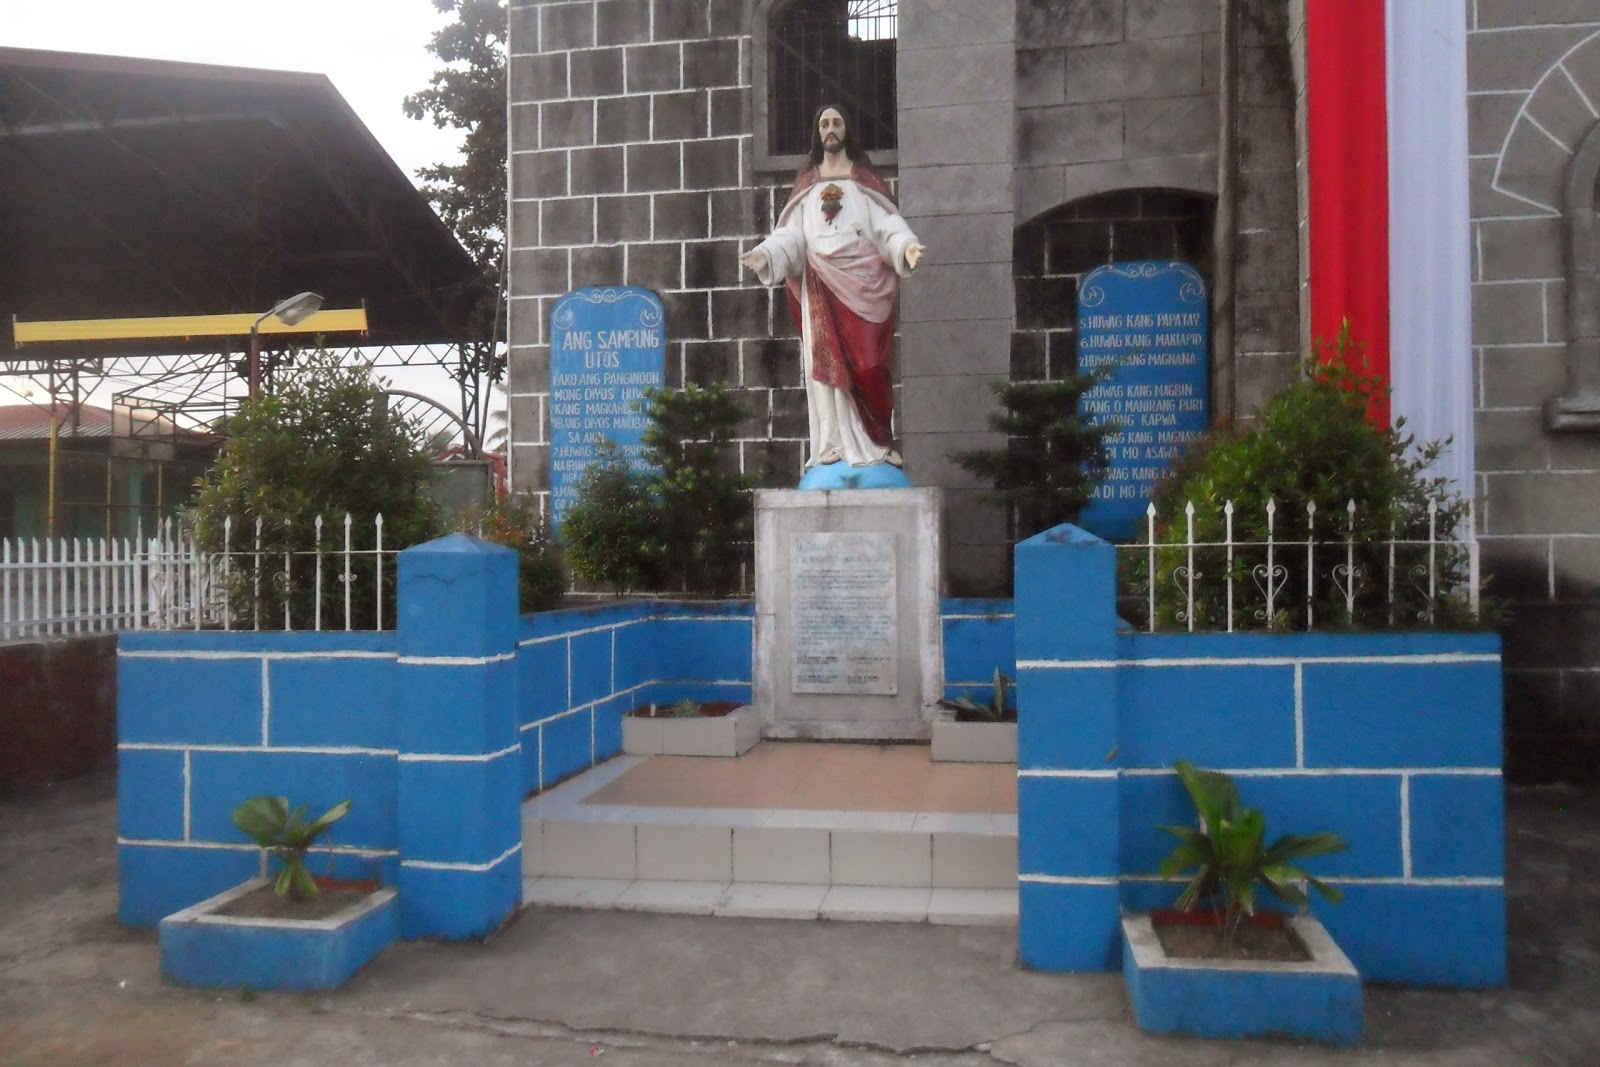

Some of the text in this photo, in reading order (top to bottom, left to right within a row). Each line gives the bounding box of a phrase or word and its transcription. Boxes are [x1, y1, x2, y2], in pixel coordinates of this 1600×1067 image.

[1126, 314, 1154, 328] KANG
[1157, 312, 1200, 327] PAPATAY
[562, 329, 659, 351] ANG SAMPUNG
[1125, 333, 1152, 347] KANG
[585, 351, 620, 369] UTOS
[579, 372, 600, 385] ANG
[603, 371, 659, 385] PANGINOON
[554, 388, 582, 401] MONG
[1127, 384, 1152, 397] KANG
[554, 403, 580, 415] KANG
[1082, 399, 1111, 413] TANG
[1125, 400, 1175, 412] MANIRANG
[1179, 398, 1203, 411] PURI
[584, 417, 611, 429] DIYOS
[568, 431, 580, 443] SA
[1128, 431, 1153, 443] KANG
[1122, 446, 1138, 459] MO
[1132, 466, 1159, 479] KANG
[1119, 485, 1136, 497] MO
